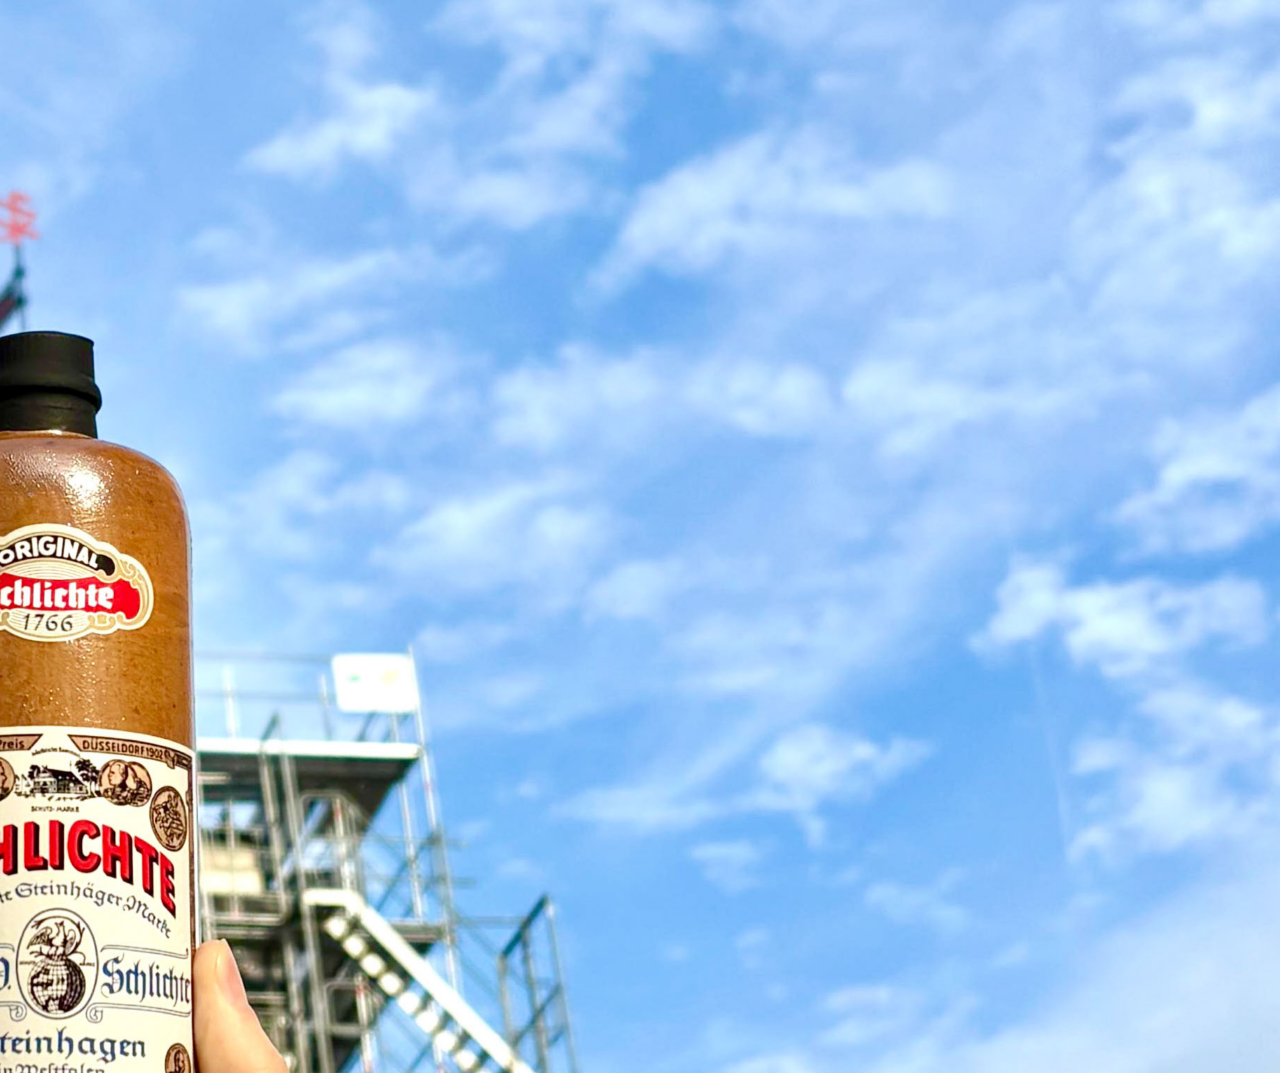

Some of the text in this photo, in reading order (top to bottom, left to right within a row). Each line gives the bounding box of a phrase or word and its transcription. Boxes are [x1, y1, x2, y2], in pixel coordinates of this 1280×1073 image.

[22, 613, 73, 632] 1766
[82, 737, 145, 756] DÜSSELDORF
[145, 746, 164, 760] 1902
[15, 880, 123, 908] Steinhäger
[123, 895, 172, 939] Marke
[101, 952, 191, 1007] Schlichte
